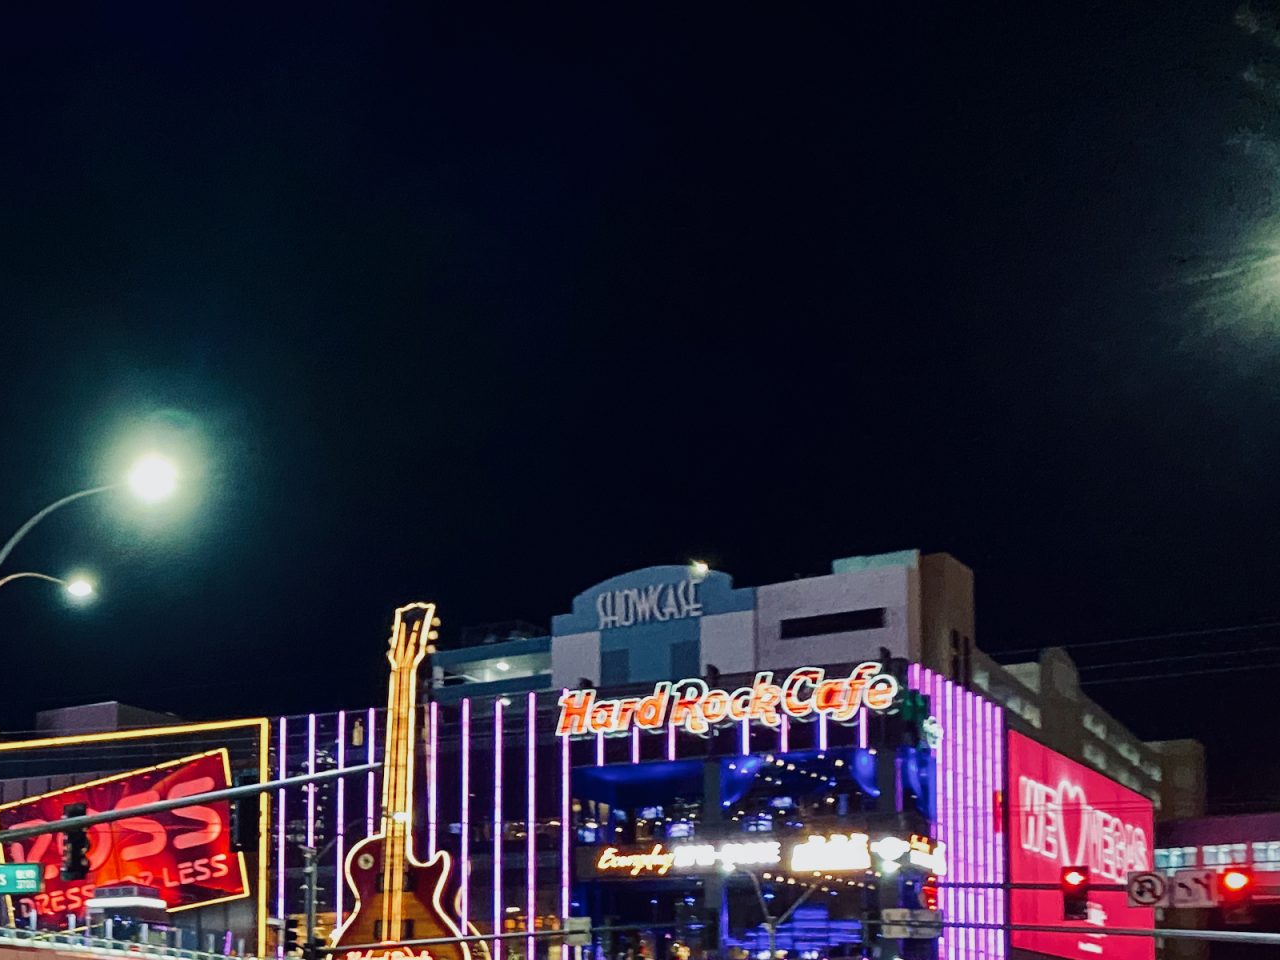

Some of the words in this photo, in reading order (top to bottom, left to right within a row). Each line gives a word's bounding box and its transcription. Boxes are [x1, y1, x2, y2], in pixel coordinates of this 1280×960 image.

[597, 579, 704, 630] SHOWCASE
[555, 681, 672, 737] Hard
[670, 671, 783, 734] Rock
[782, 661, 899, 722] Cafe
[19, 884, 96, 916] DRESS
[162, 854, 229, 888] LESS
